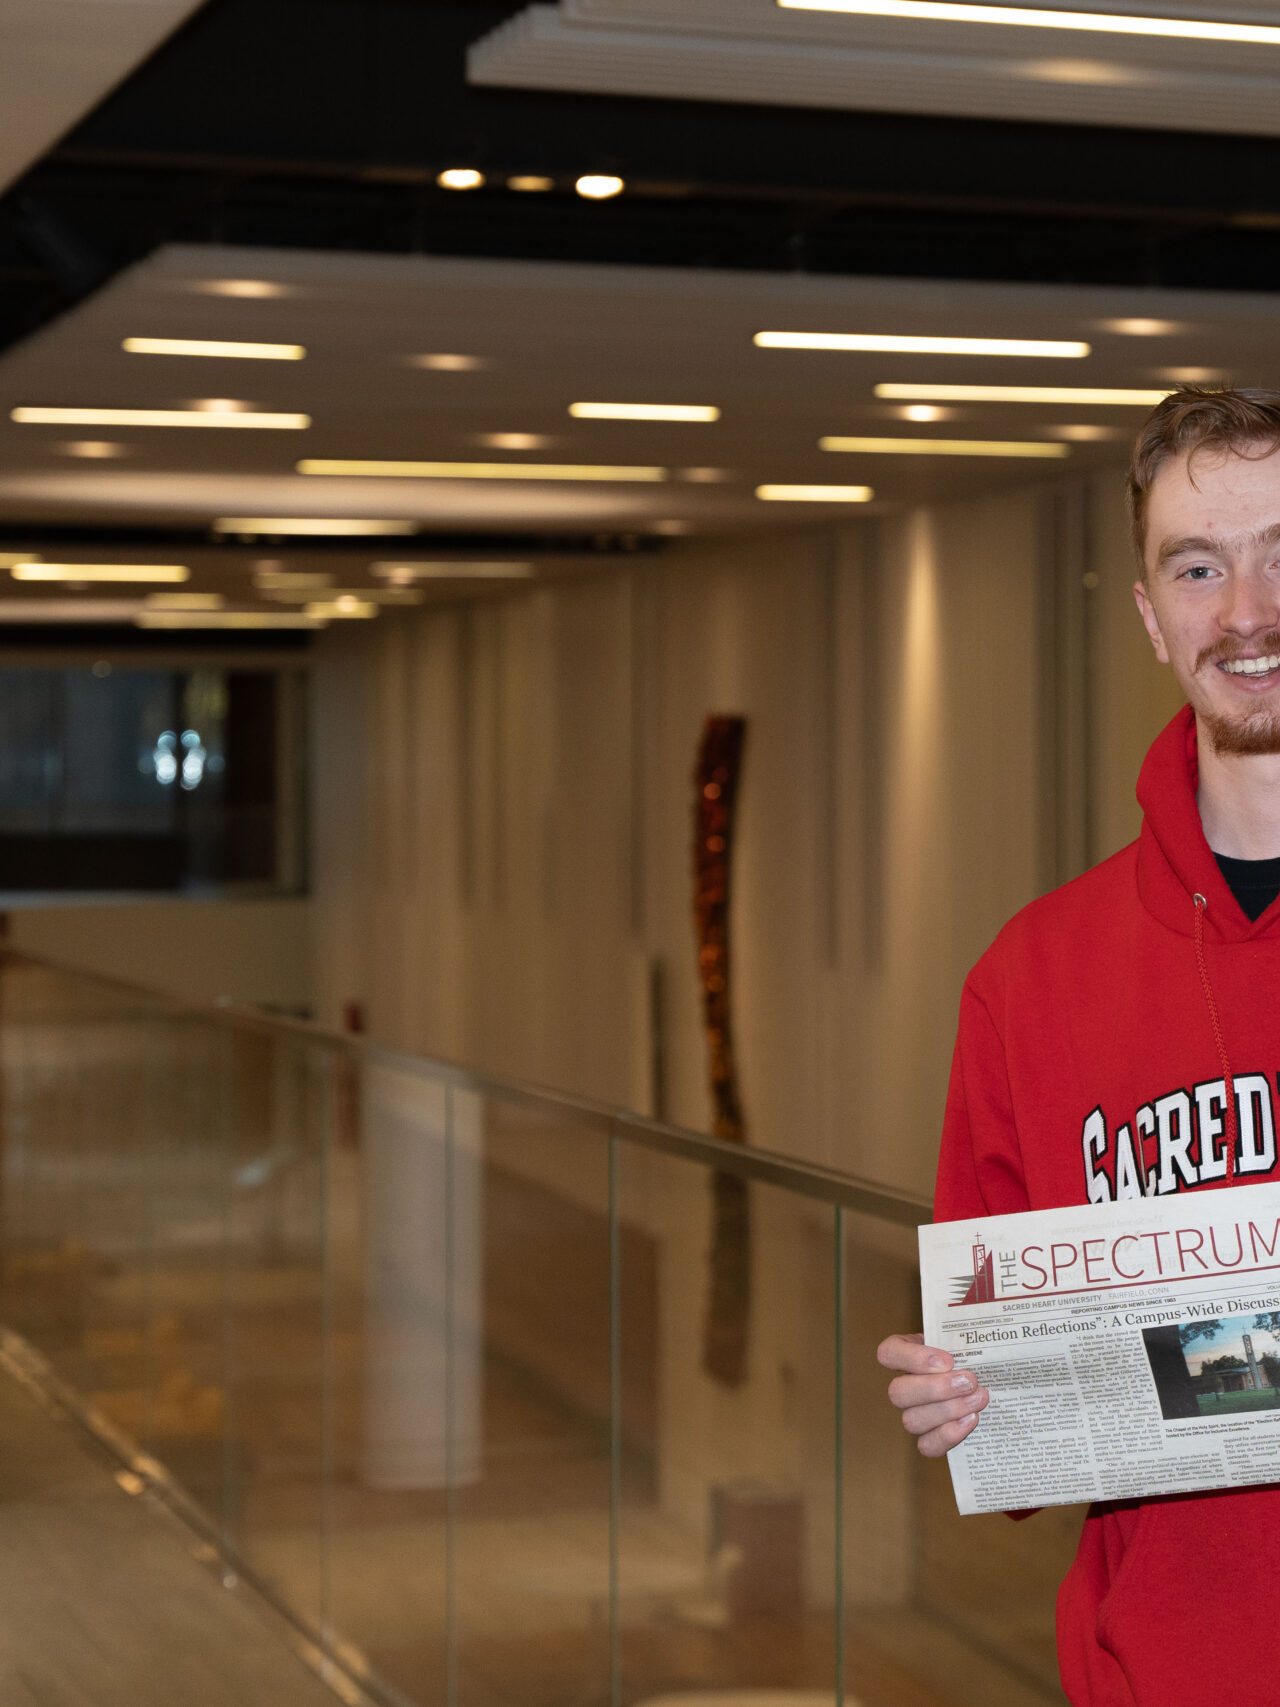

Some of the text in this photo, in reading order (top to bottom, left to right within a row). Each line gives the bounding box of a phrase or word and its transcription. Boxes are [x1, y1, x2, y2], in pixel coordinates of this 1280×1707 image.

[1082, 1072, 1278, 1204] SACRED
[999, 1250, 1017, 1292] THE
[1002, 1302, 1030, 1311] SACRED
[1031, 1299, 1056, 1308] HEART
[1057, 1294, 1102, 1305] UNIVERSITY
[1070, 1306, 1102, 1314] REPORTING
[1110, 1315, 1121, 1326] A
[1124, 1302, 1223, 1323] Campus-Wide
